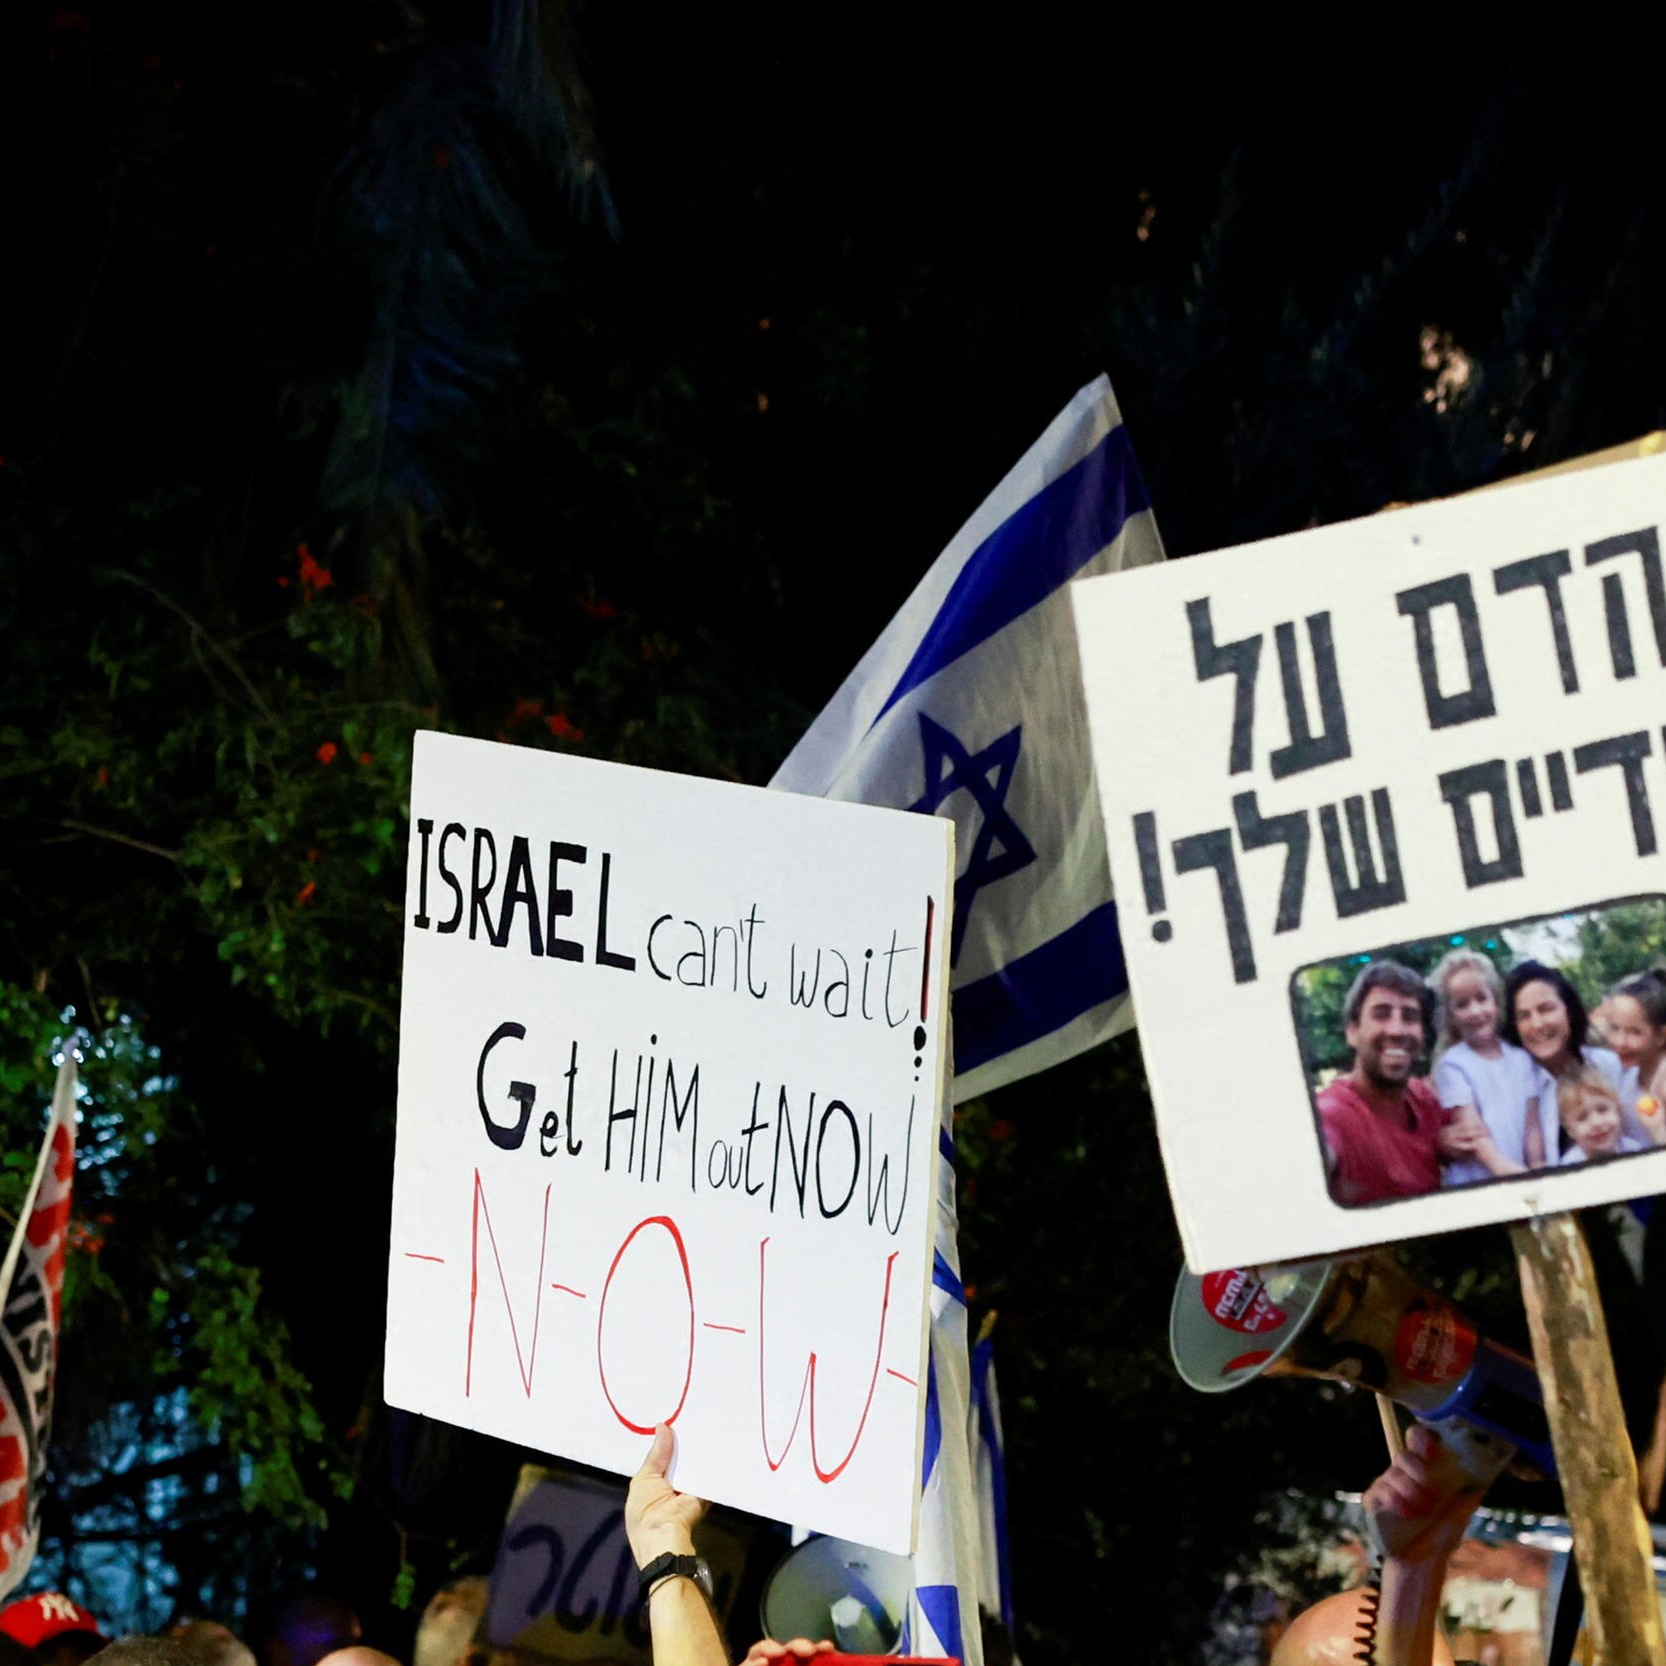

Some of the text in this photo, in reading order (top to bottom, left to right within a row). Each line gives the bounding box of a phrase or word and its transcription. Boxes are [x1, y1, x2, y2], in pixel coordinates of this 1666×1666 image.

[1185, 596, 1353, 781] על
[413, 817, 637, 973] ISRAEL
[645, 902, 768, 1000] can't
[1130, 786, 1409, 985] שלך!
[475, 1020, 584, 1158] Get
